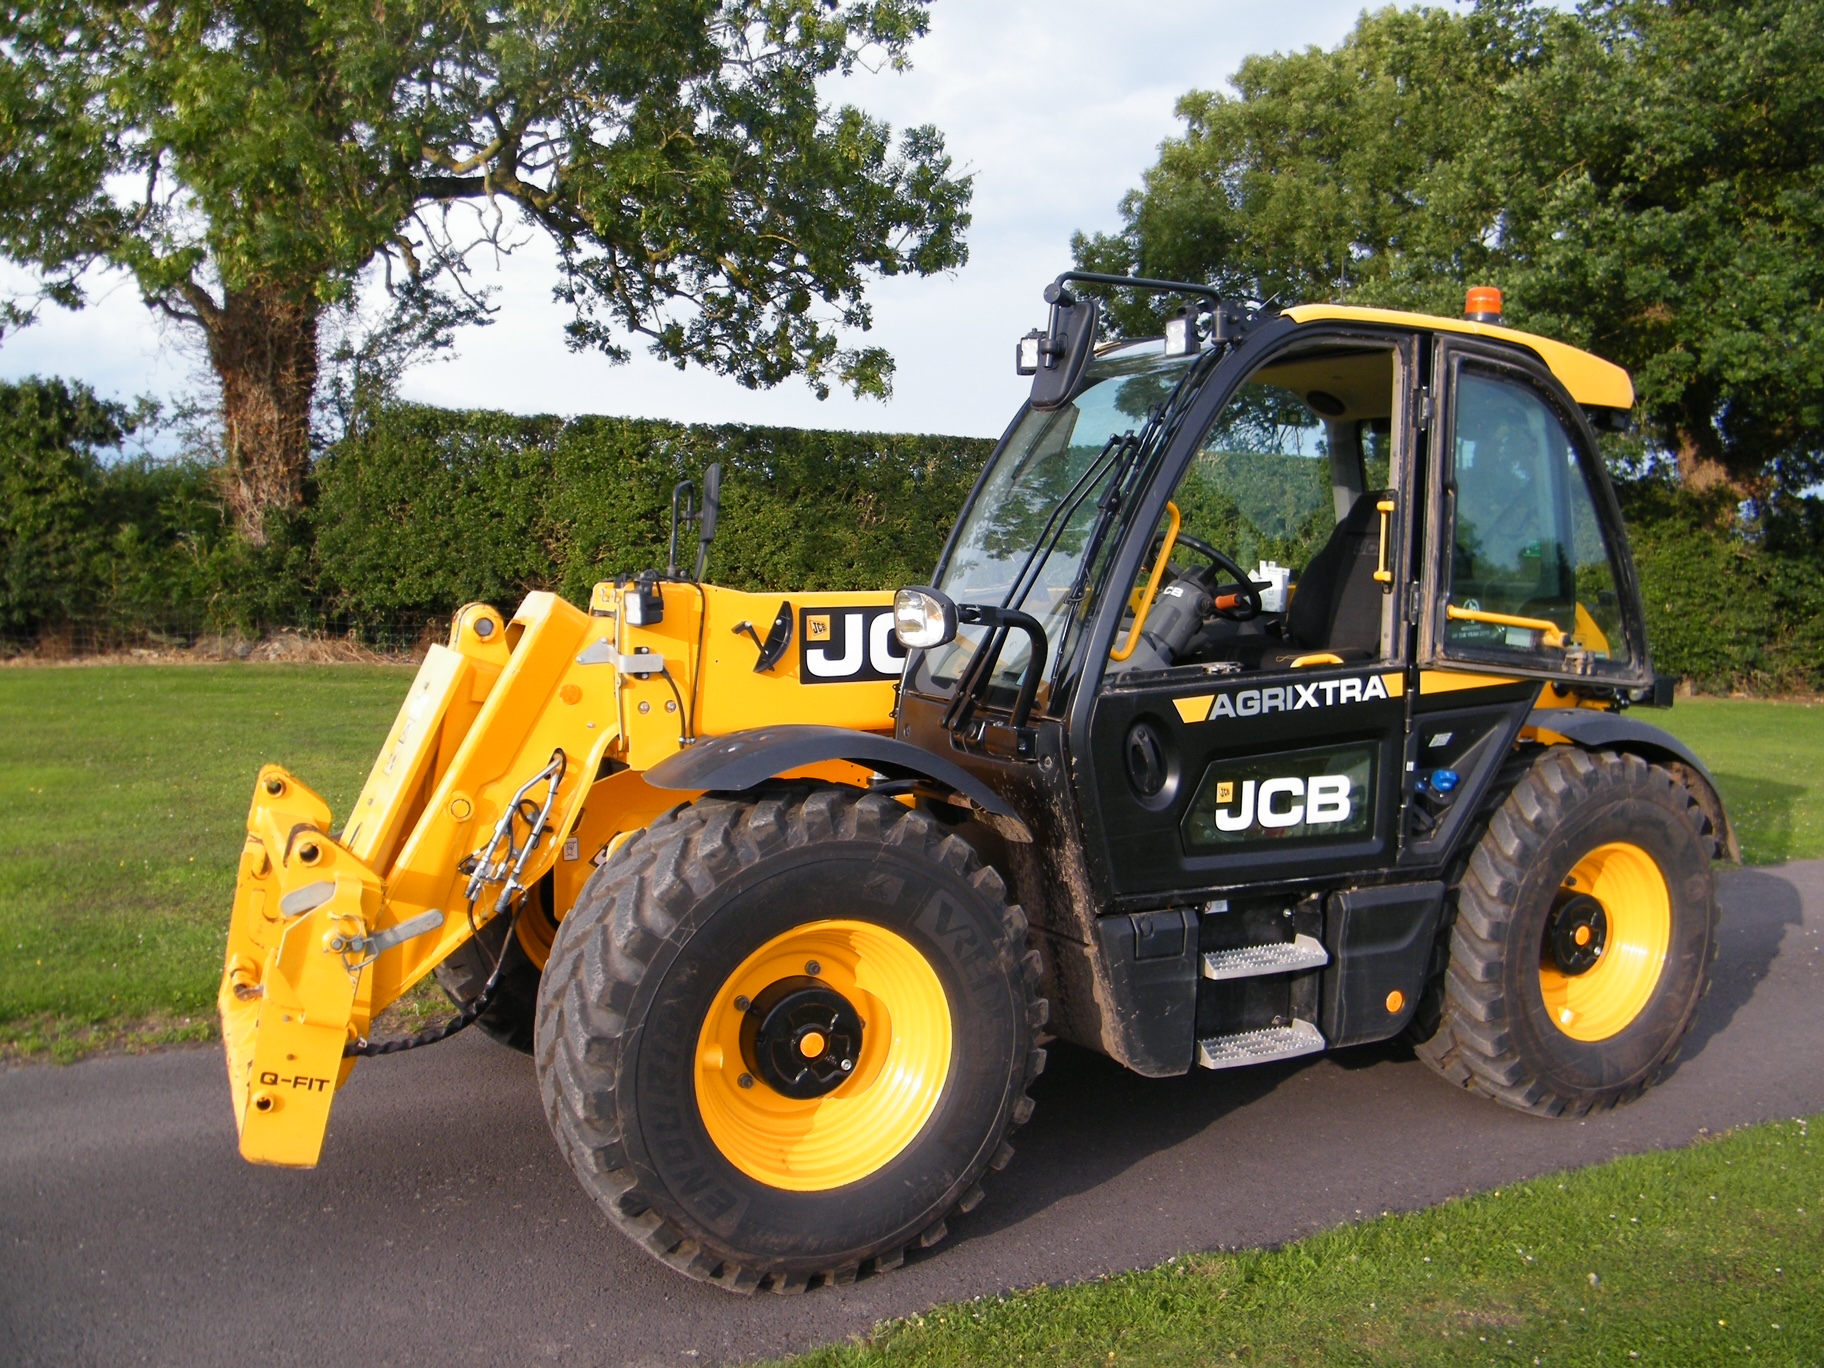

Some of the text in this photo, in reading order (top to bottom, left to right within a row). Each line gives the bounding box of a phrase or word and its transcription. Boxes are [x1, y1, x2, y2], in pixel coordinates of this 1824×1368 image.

[1163, 586, 1184, 598] CB
[806, 612, 908, 677] JC
[1209, 675, 1388, 721] AGRIXTRA
[1215, 775, 1351, 832] JCB
[259, 1071, 330, 1092] Q-FIT
